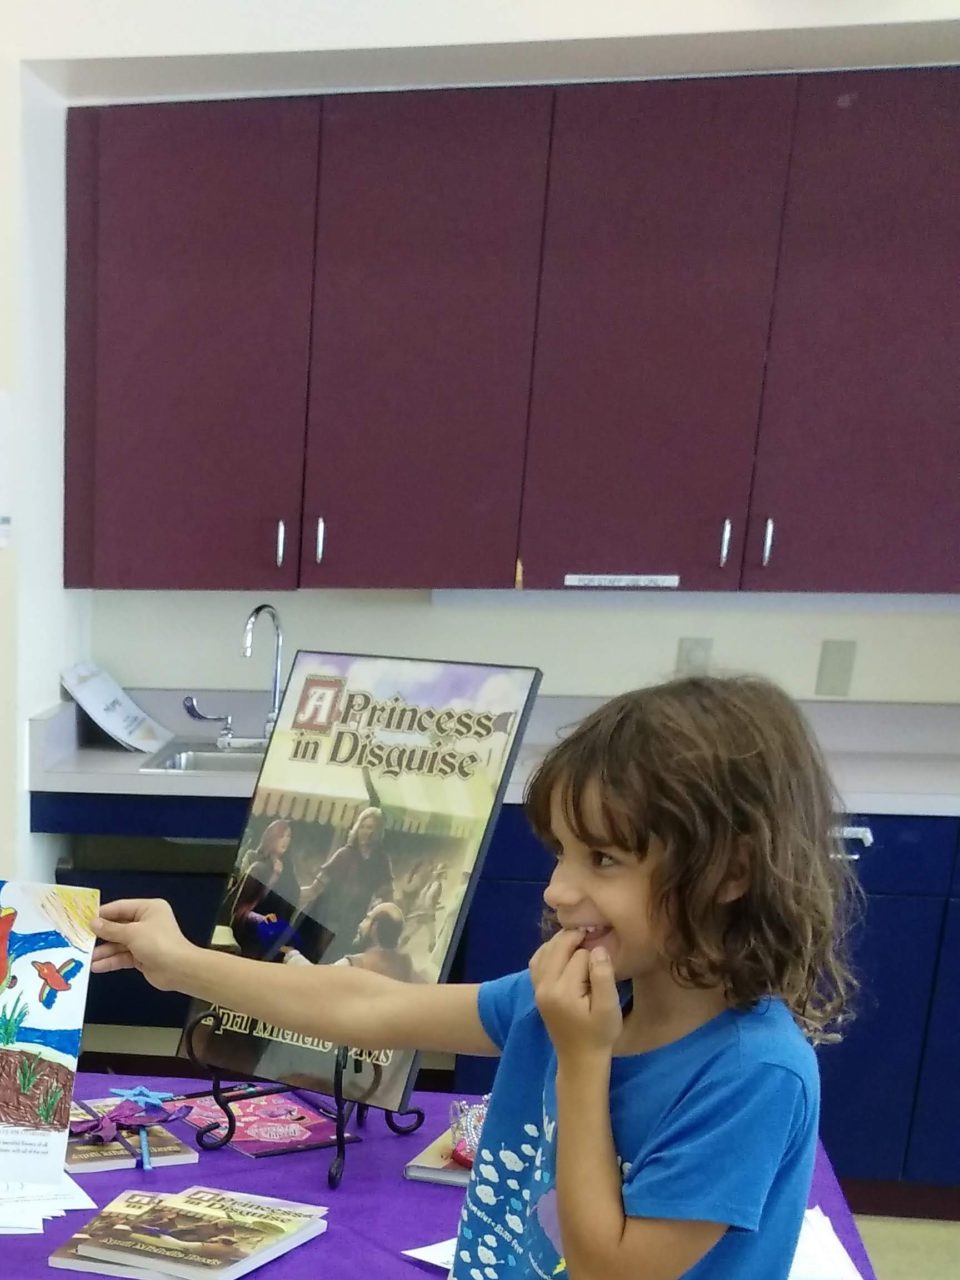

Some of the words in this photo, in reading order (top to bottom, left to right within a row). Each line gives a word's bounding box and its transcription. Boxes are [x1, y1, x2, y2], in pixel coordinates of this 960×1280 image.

[340, 690, 494, 740] Princess
[290, 731, 321, 760] in
[327, 730, 480, 779] Disguise
